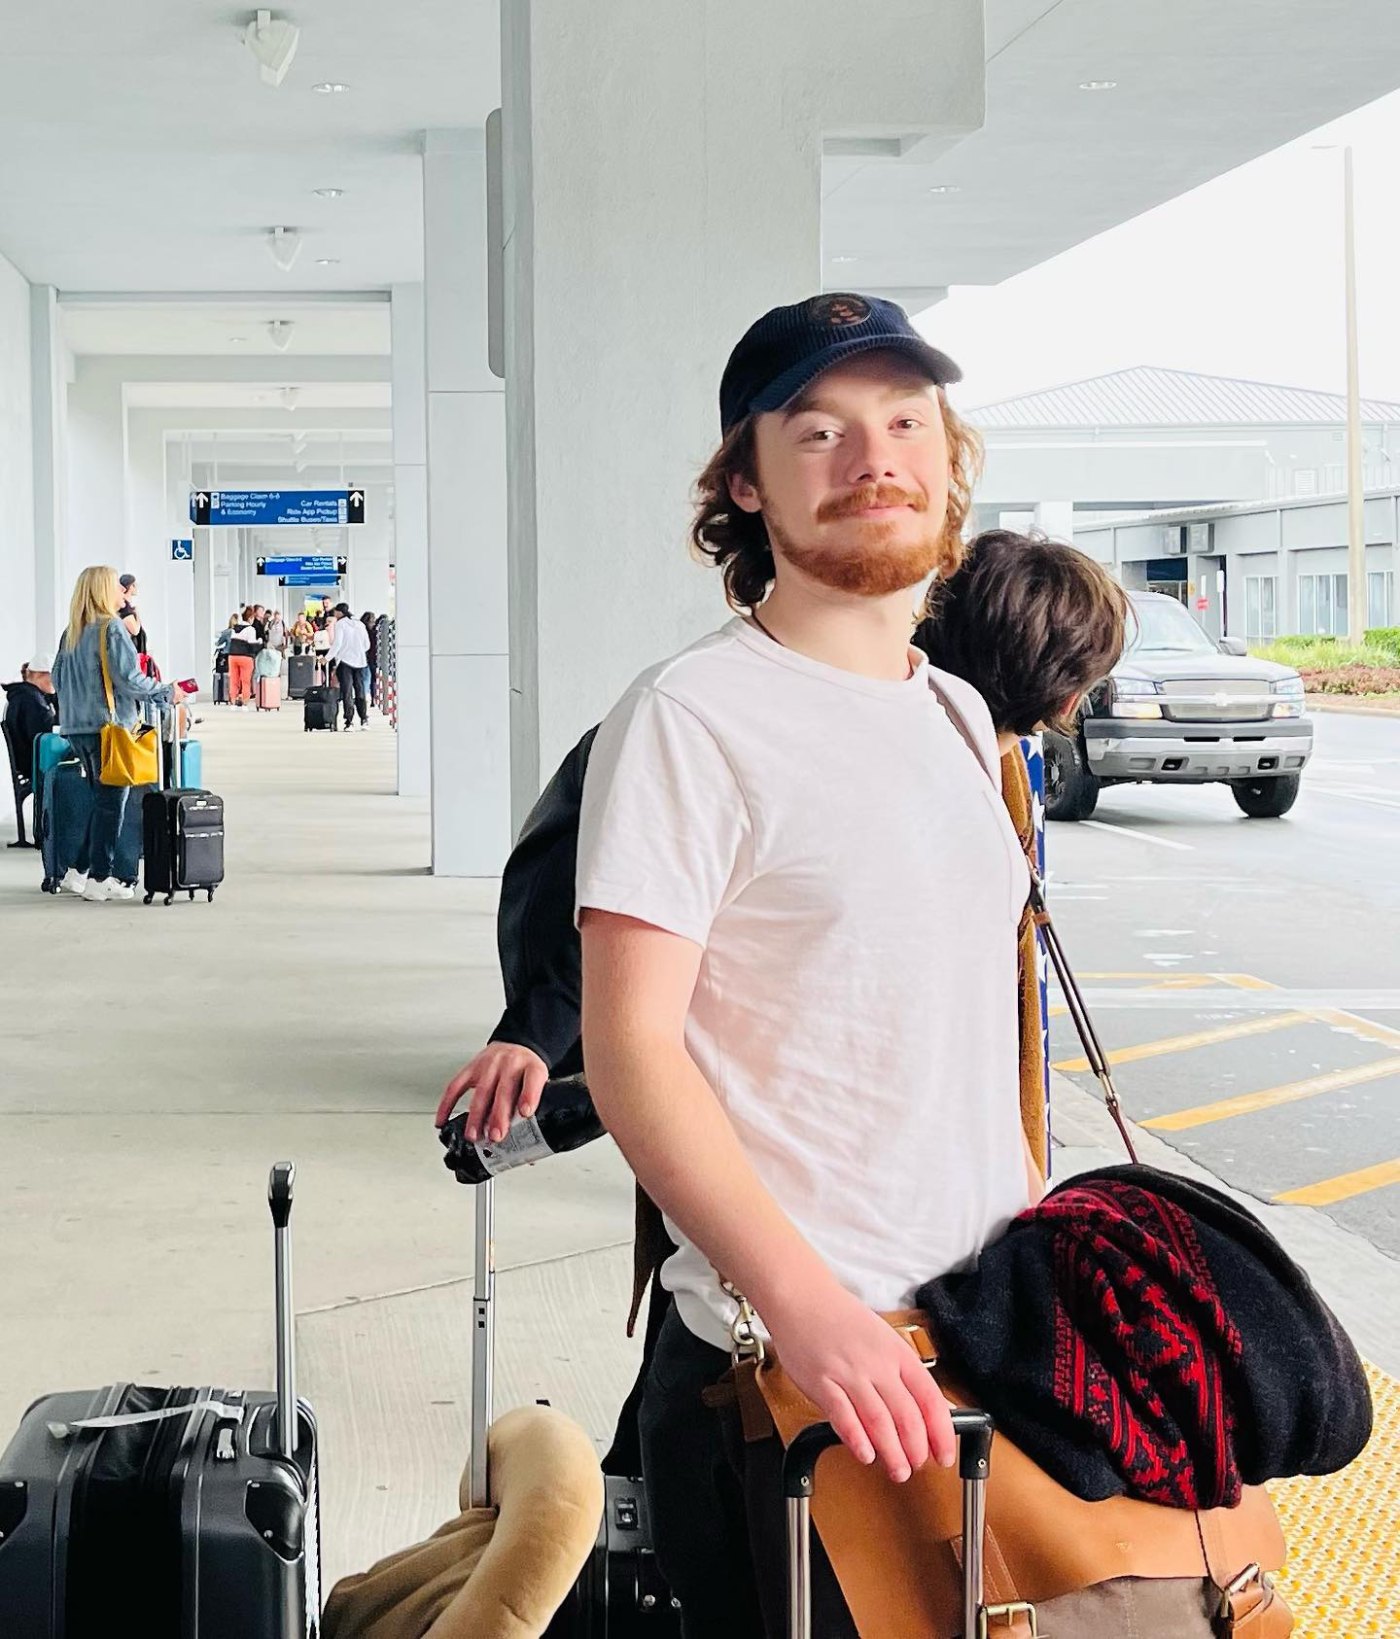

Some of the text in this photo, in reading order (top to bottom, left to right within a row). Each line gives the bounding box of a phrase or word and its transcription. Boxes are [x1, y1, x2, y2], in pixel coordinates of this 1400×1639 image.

[220, 493, 249, 501] Baggage
[220, 501, 245, 509] Parking
[302, 508, 316, 516] App
